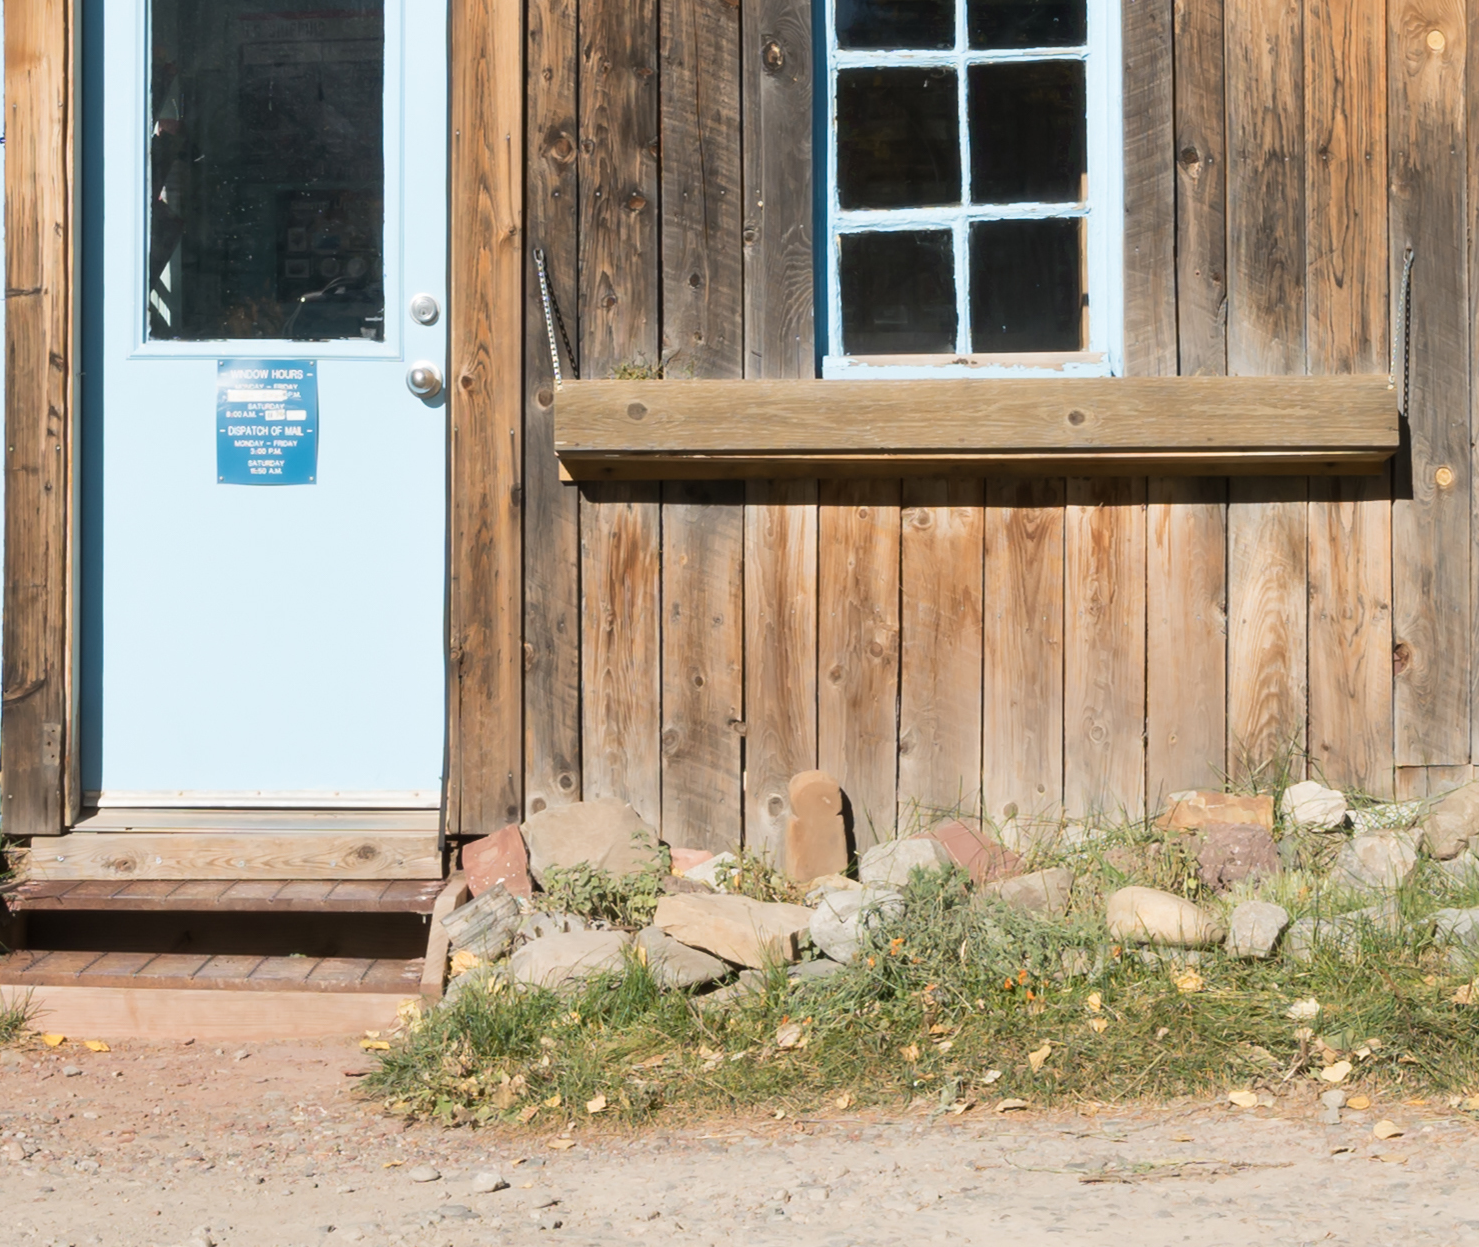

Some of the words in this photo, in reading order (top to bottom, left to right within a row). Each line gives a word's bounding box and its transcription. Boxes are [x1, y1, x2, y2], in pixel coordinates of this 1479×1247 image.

[230, 369, 269, 380] WINDOW
[272, 369, 304, 380] HOURS
[228, 425, 269, 436] DISPATCH
[270, 425, 283, 436] OF
[284, 426, 304, 436] MAIL
